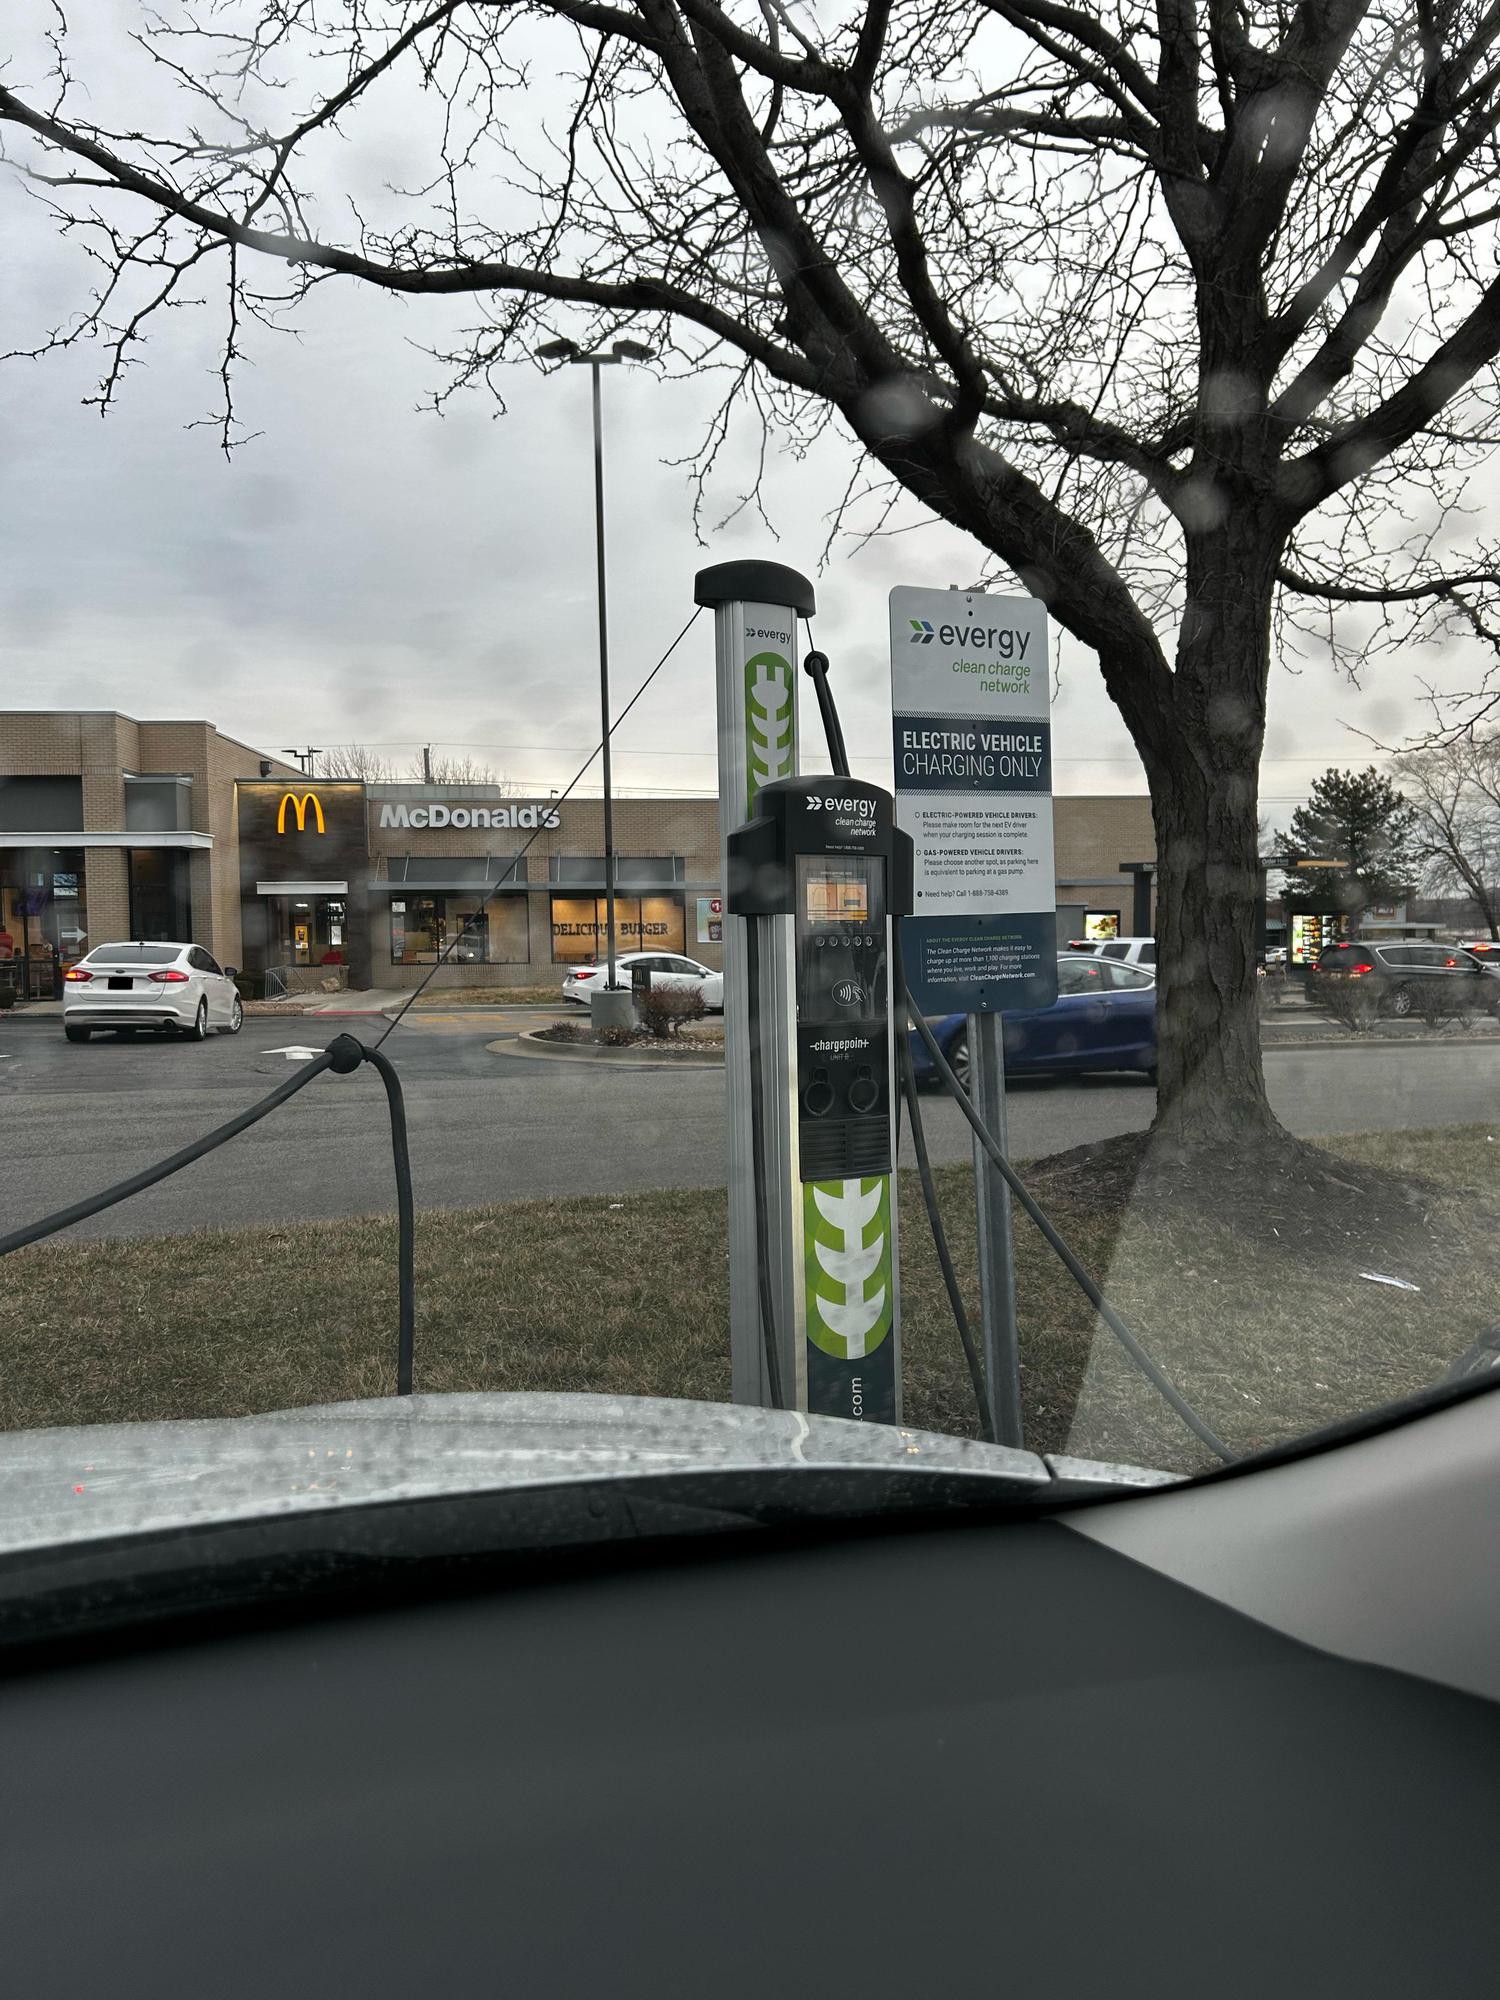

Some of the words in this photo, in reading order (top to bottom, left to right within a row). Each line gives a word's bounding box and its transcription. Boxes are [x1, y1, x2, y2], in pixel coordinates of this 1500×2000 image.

[757, 629, 791, 644] evergy
[939, 624, 1031, 660] evergy
[952, 659, 986, 674] clean
[989, 661, 1031, 681] charge
[981, 680, 1030, 694] network
[903, 731, 976, 750] ELECTRIC
[981, 734, 1042, 752] VEHICLE
[903, 753, 995, 776] CHARGING
[1000, 756, 1042, 777] ONLY
[825, 797, 877, 818] evergy
[379, 804, 561, 829] McDonald's
[835, 817, 854, 826] clean
[854, 818, 877, 829] charge
[923, 821, 942, 829] Please
[942, 821, 958, 829] make
[973, 821, 982, 829] for
[982, 821, 991, 829] the
[1013, 821, 1027, 829] driver
[850, 828, 877, 837] network
[939, 832, 951, 840] your
[951, 831, 976, 840] charging
[976, 831, 997, 839] session
[1007, 858, 1027, 867] parking
[930, 868, 958, 877] equivalent
[965, 868, 987, 877] parking
[941, 890, 956, 899] help?
[956, 890, 967, 898] Call
[553, 922, 615, 936] DELICIOU
[621, 922, 669, 936] BURGER
[937, 947, 952, 955] Clean
[952, 947, 971, 956] Charge
[971, 946, 993, 954] Network
[926, 957, 945, 966] charge
[927, 966, 943, 974] where
[943, 967, 953, 975] you
[977, 964, 987, 972] and
[1008, 963, 1022, 971] more
